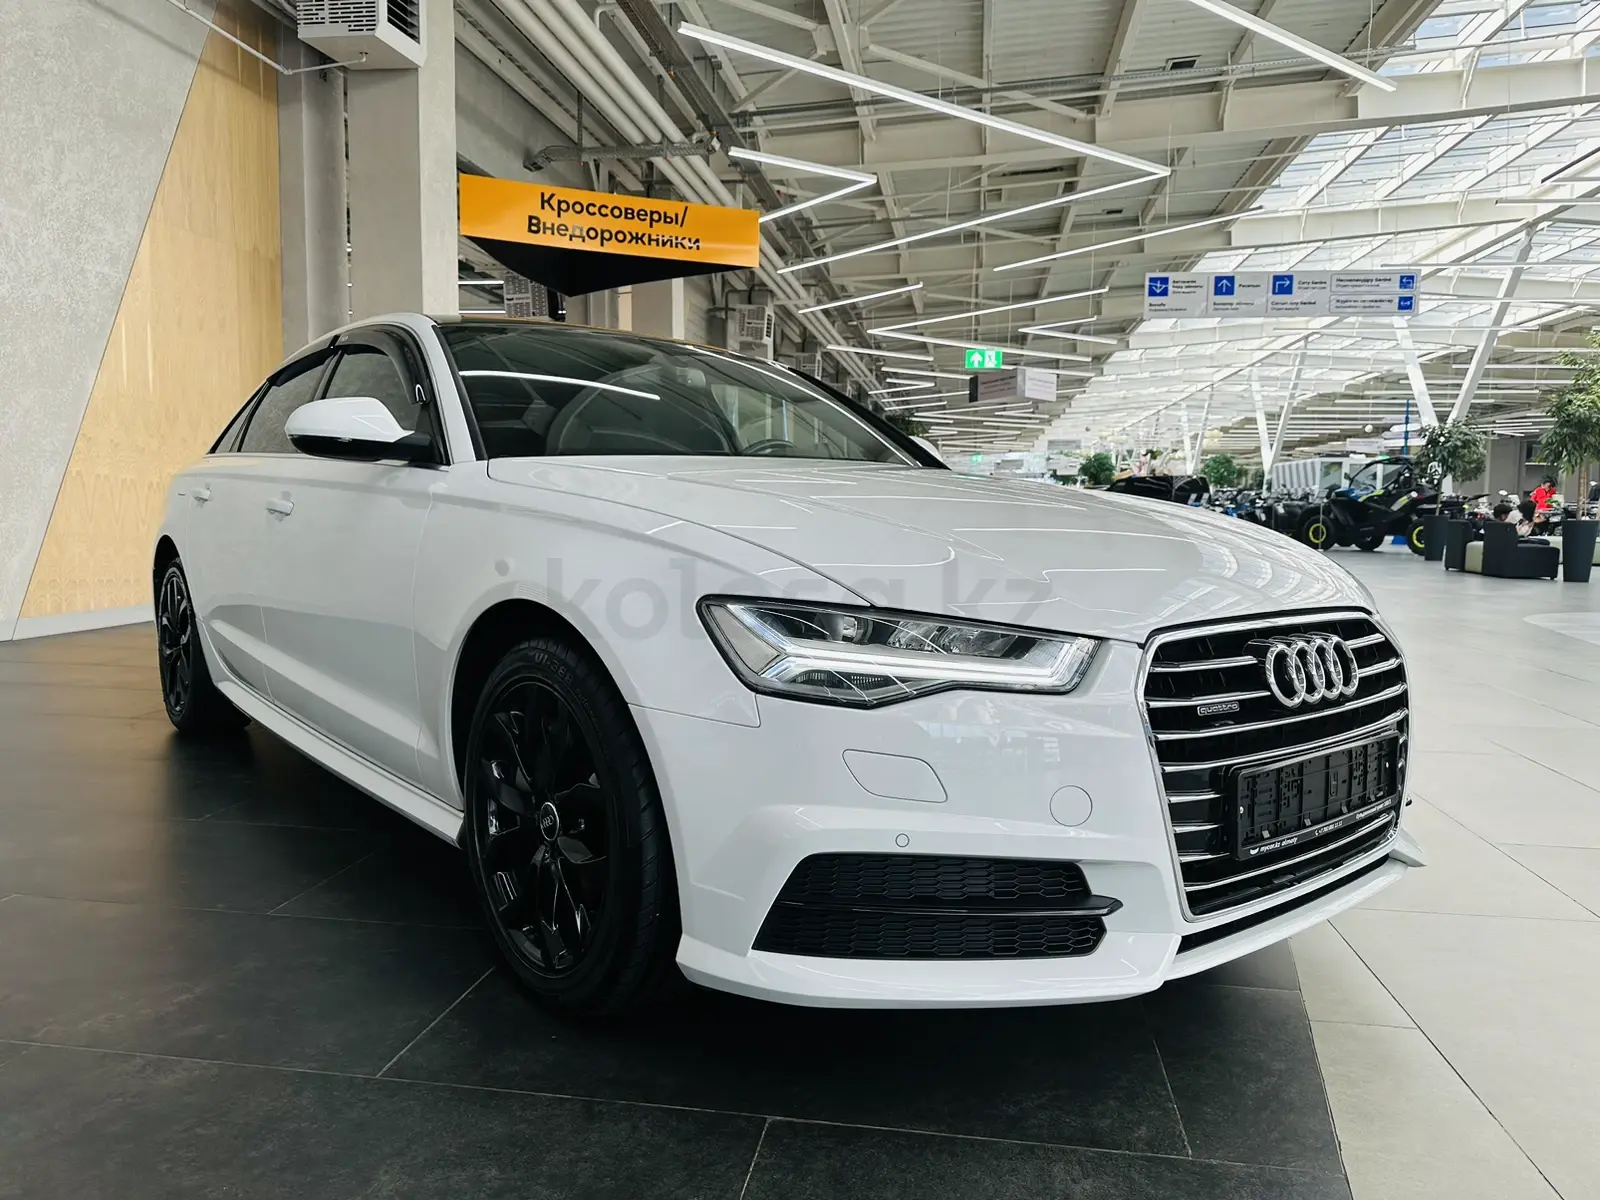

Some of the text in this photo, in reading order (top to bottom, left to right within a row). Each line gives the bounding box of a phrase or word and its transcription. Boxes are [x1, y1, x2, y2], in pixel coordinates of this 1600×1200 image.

[540, 191, 688, 228] Кроссоверы/
[527, 215, 700, 250] Внедорожники
[1200, 703, 1238, 715] quattro
